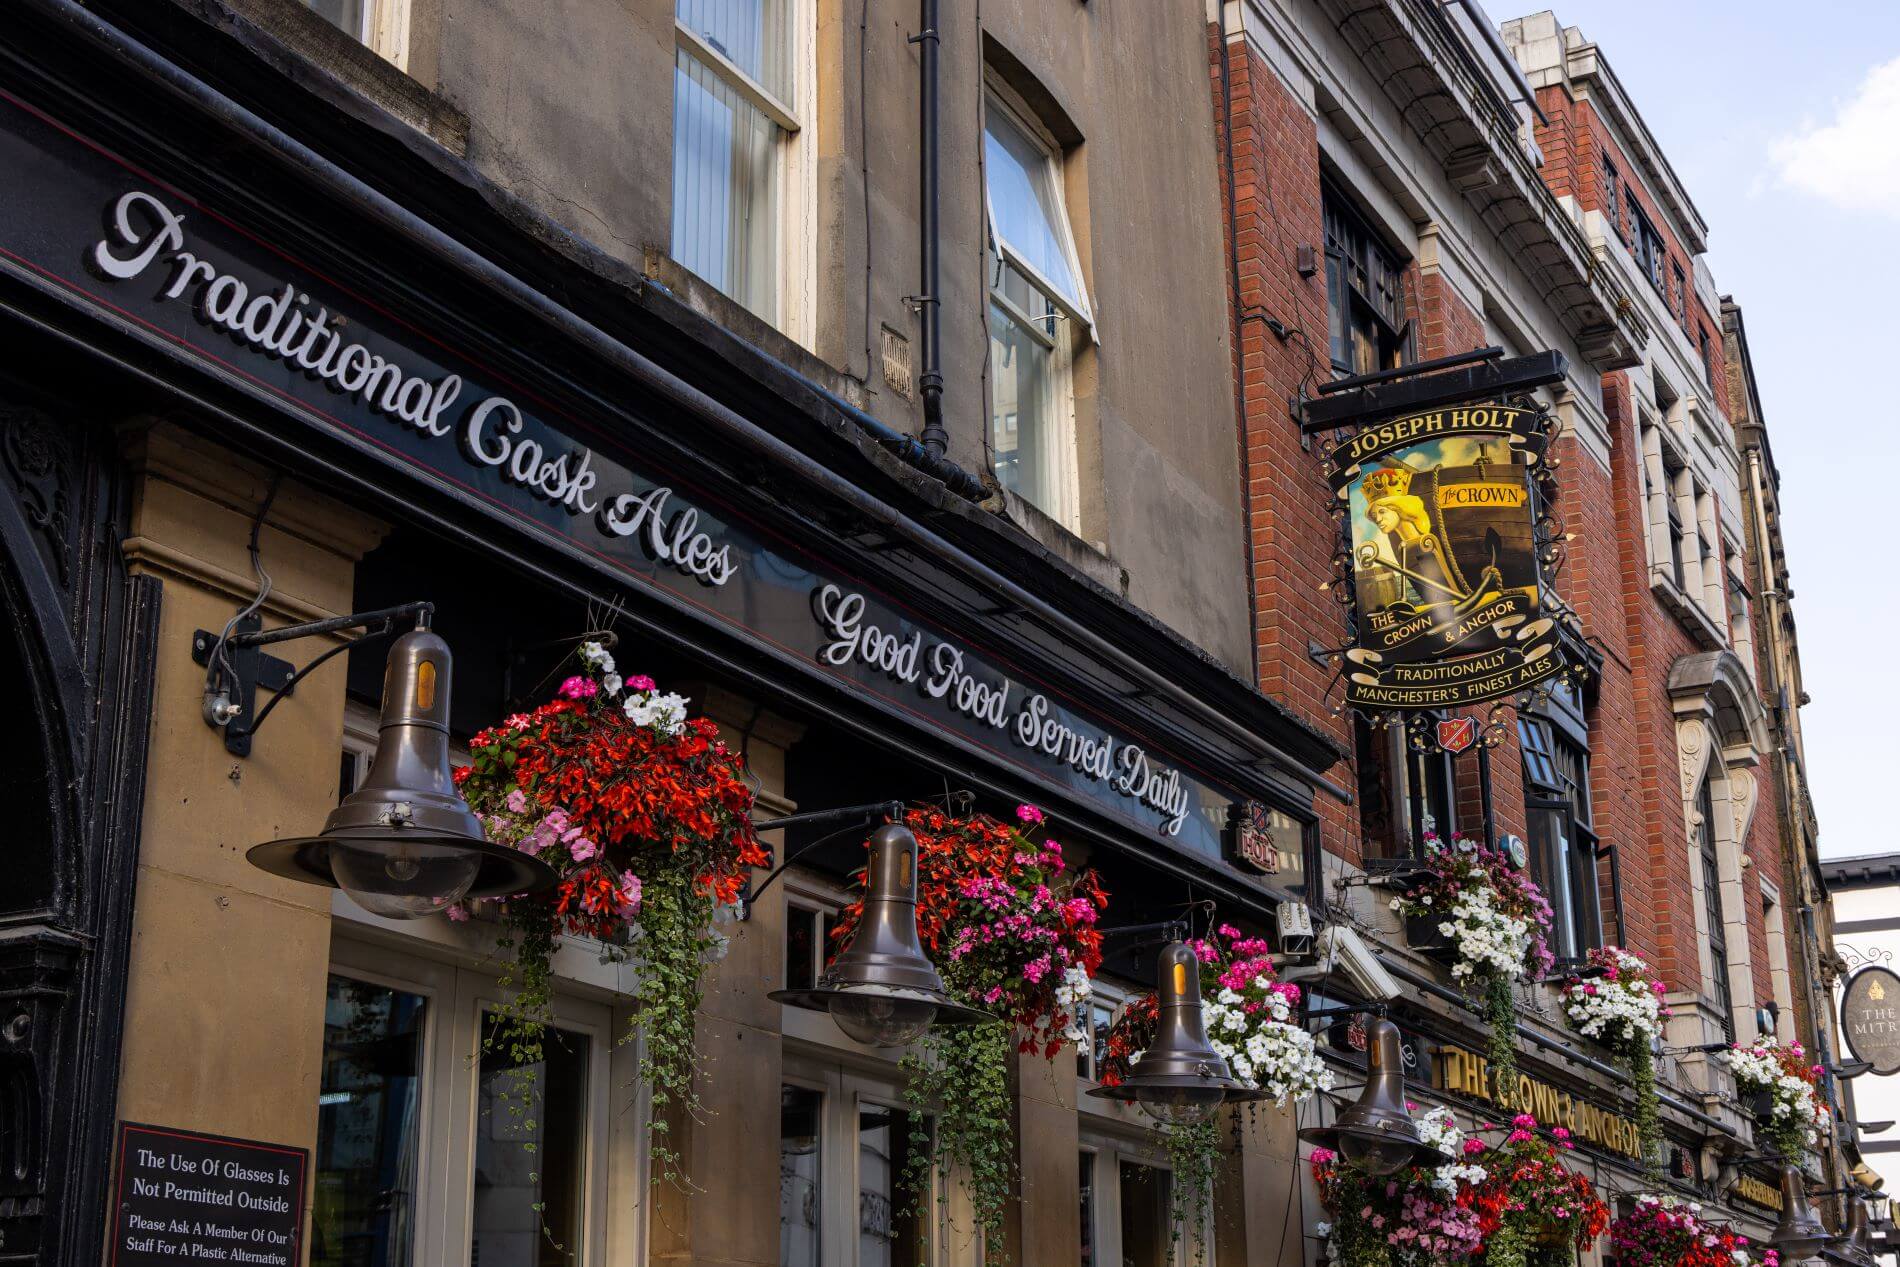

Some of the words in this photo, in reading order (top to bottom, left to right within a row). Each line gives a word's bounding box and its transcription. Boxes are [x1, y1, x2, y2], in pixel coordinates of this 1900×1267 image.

[97, 192, 461, 437] Traditional
[468, 396, 599, 513] Cask
[608, 487, 738, 586] Ales
[1350, 413, 1443, 458] JOSEPH
[1451, 409, 1519, 429] HOLT
[1456, 487, 1518, 503] CROWN
[1371, 612, 1396, 629] THE
[1383, 616, 1433, 646] CROWN
[1445, 631, 1455, 643] &
[1458, 600, 1516, 637] ANCHOR
[1356, 686, 1459, 703] MANCHESTER'S
[1468, 673, 1513, 696] FINEST
[1520, 657, 1552, 681] ALES
[1395, 653, 1506, 681] TRADITIONALLY
[820, 584, 921, 684] Good
[927, 643, 1009, 729] Food
[1018, 694, 1114, 783] Served
[1119, 744, 1189, 837] Daily
[1243, 834, 1278, 868] HOLT
[1855, 1021, 1898, 1035] MITR
[1862, 1007, 1897, 1020] THE
[1429, 1045, 1491, 1100] THE
[138, 1149, 165, 1169] The
[170, 1154, 197, 1173] Use
[201, 1158, 220, 1176] Of
[224, 1162, 274, 1184] Glasses
[278, 1169, 290, 1186] Is
[133, 1178, 160, 1198] Not
[164, 1182, 233, 1206] Permitted
[238, 1192, 289, 1213] Outside
[129, 1215, 165, 1231] Please
[168, 1219, 189, 1234] Ask
[193, 1223, 201, 1235] A
[204, 1224, 247, 1240] Member
[251, 1229, 265, 1242] Of
[267, 1231, 288, 1245] Our
[126, 1237, 154, 1252] Staff
[157, 1240, 176, 1255] For
[179, 1244, 188, 1256] A
[192, 1243, 226, 1260] Plastic
[230, 1250, 287, 1266] Alternative
